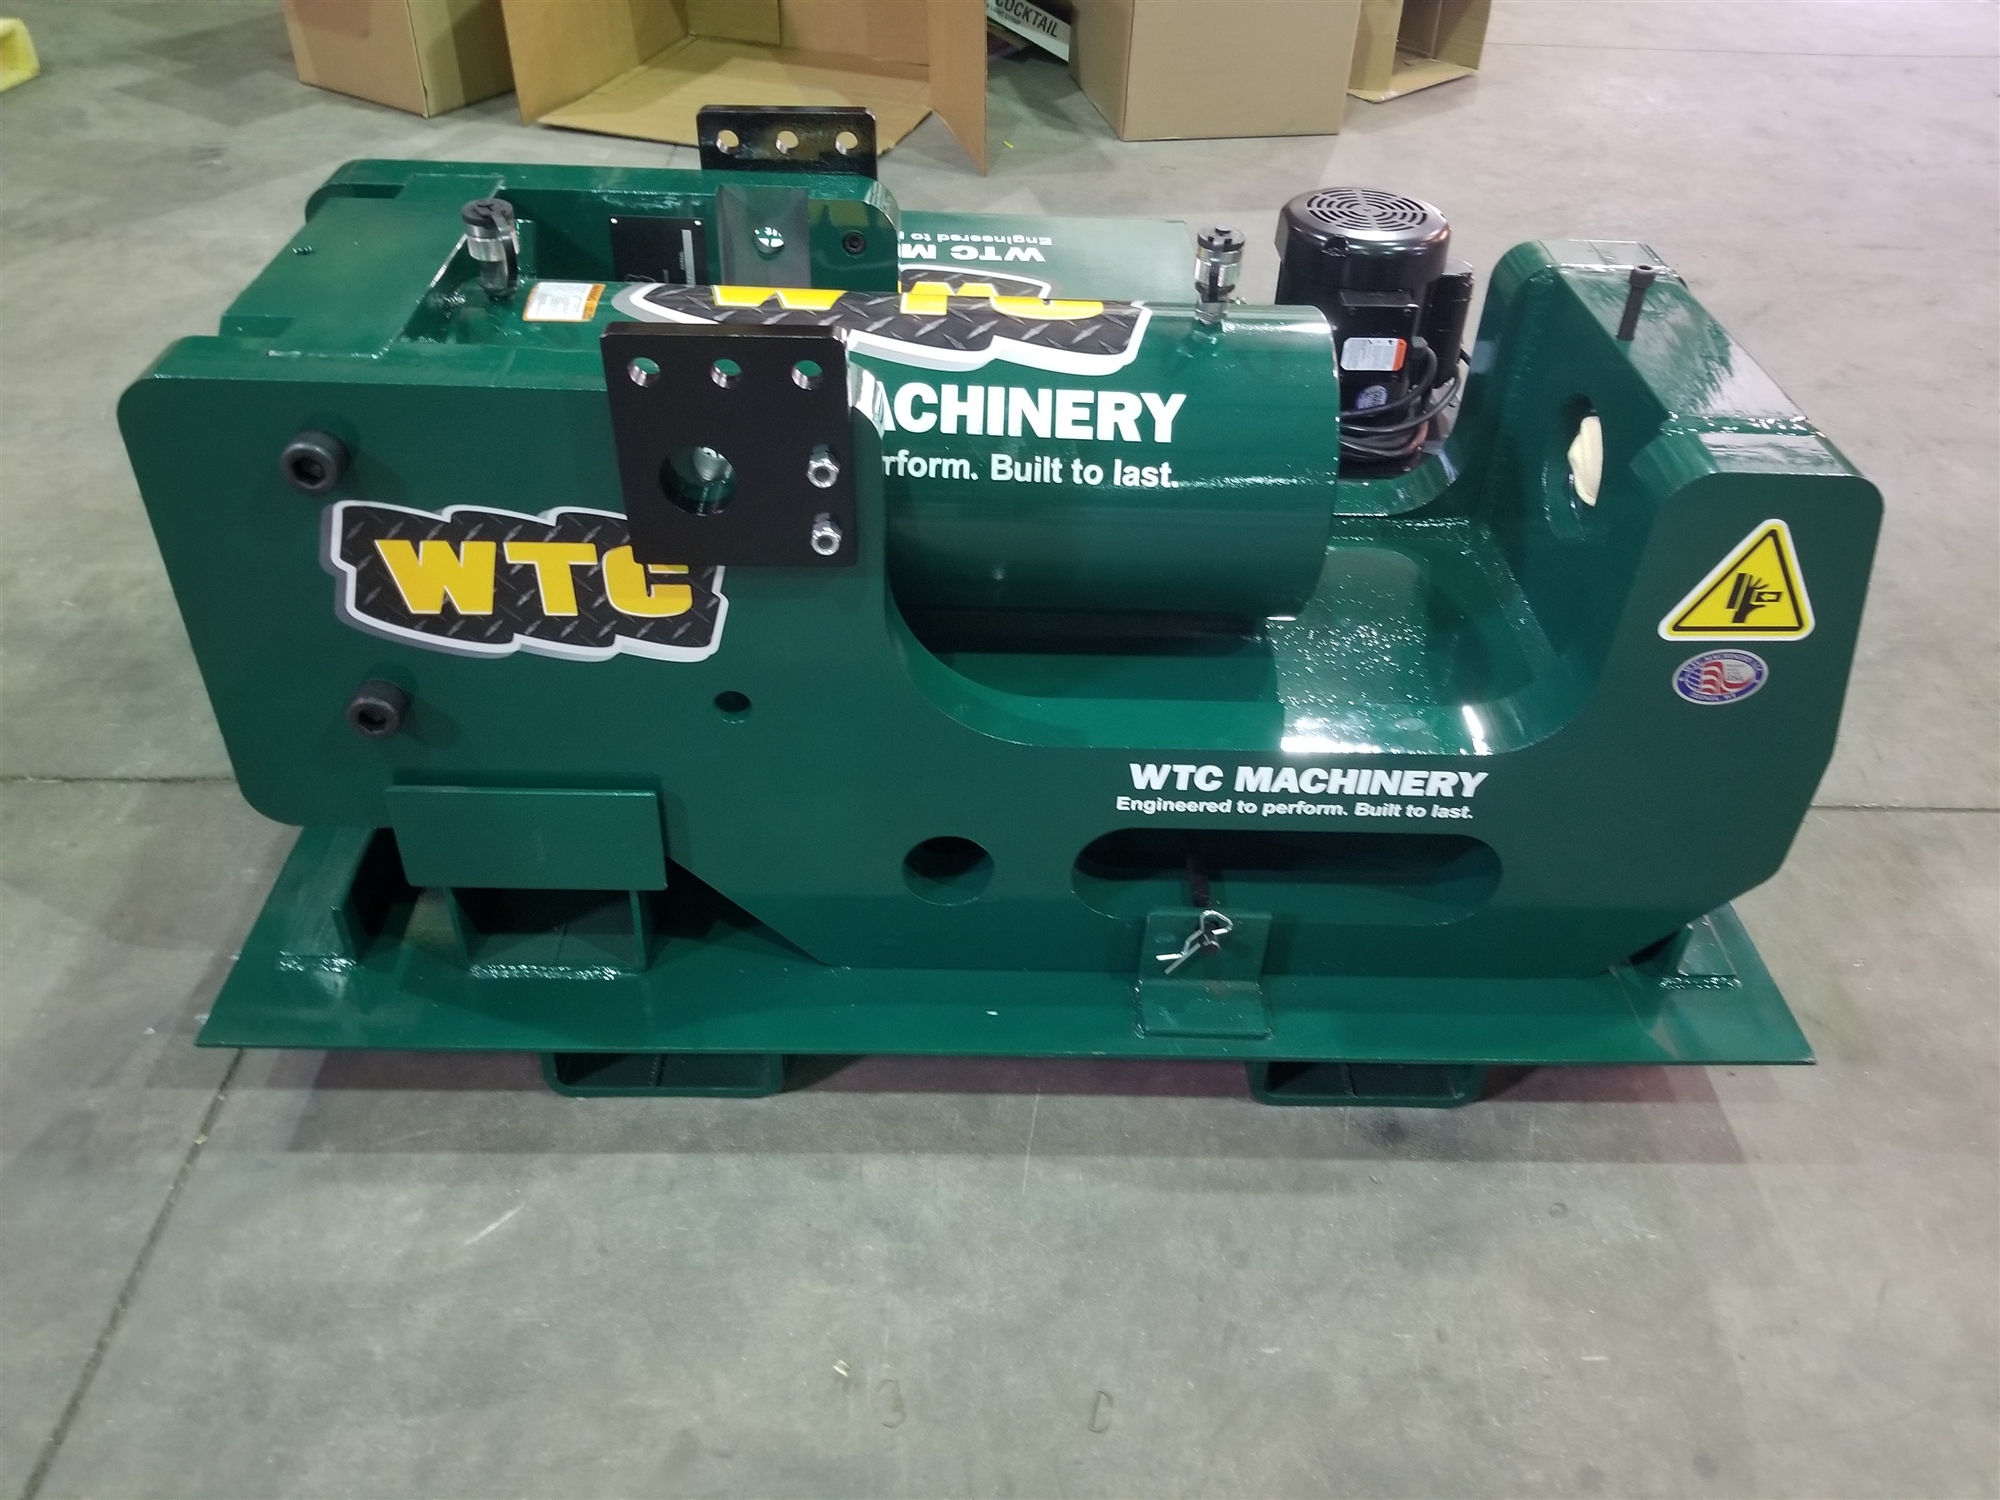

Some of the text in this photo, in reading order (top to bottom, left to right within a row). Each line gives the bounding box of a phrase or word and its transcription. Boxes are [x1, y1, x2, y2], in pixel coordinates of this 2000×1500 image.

[910, 232, 932, 242] to
[937, 233, 1053, 247] Engineered
[950, 245, 1046, 262] WTC
[875, 381, 1187, 443] CHINERY
[882, 450, 1179, 488] rform. Built to last.
[374, 539, 693, 618] WTC
[1129, 763, 1489, 798] WTC MACHINERY
[1116, 796, 1474, 819] Engineered to perform. Built to last.
